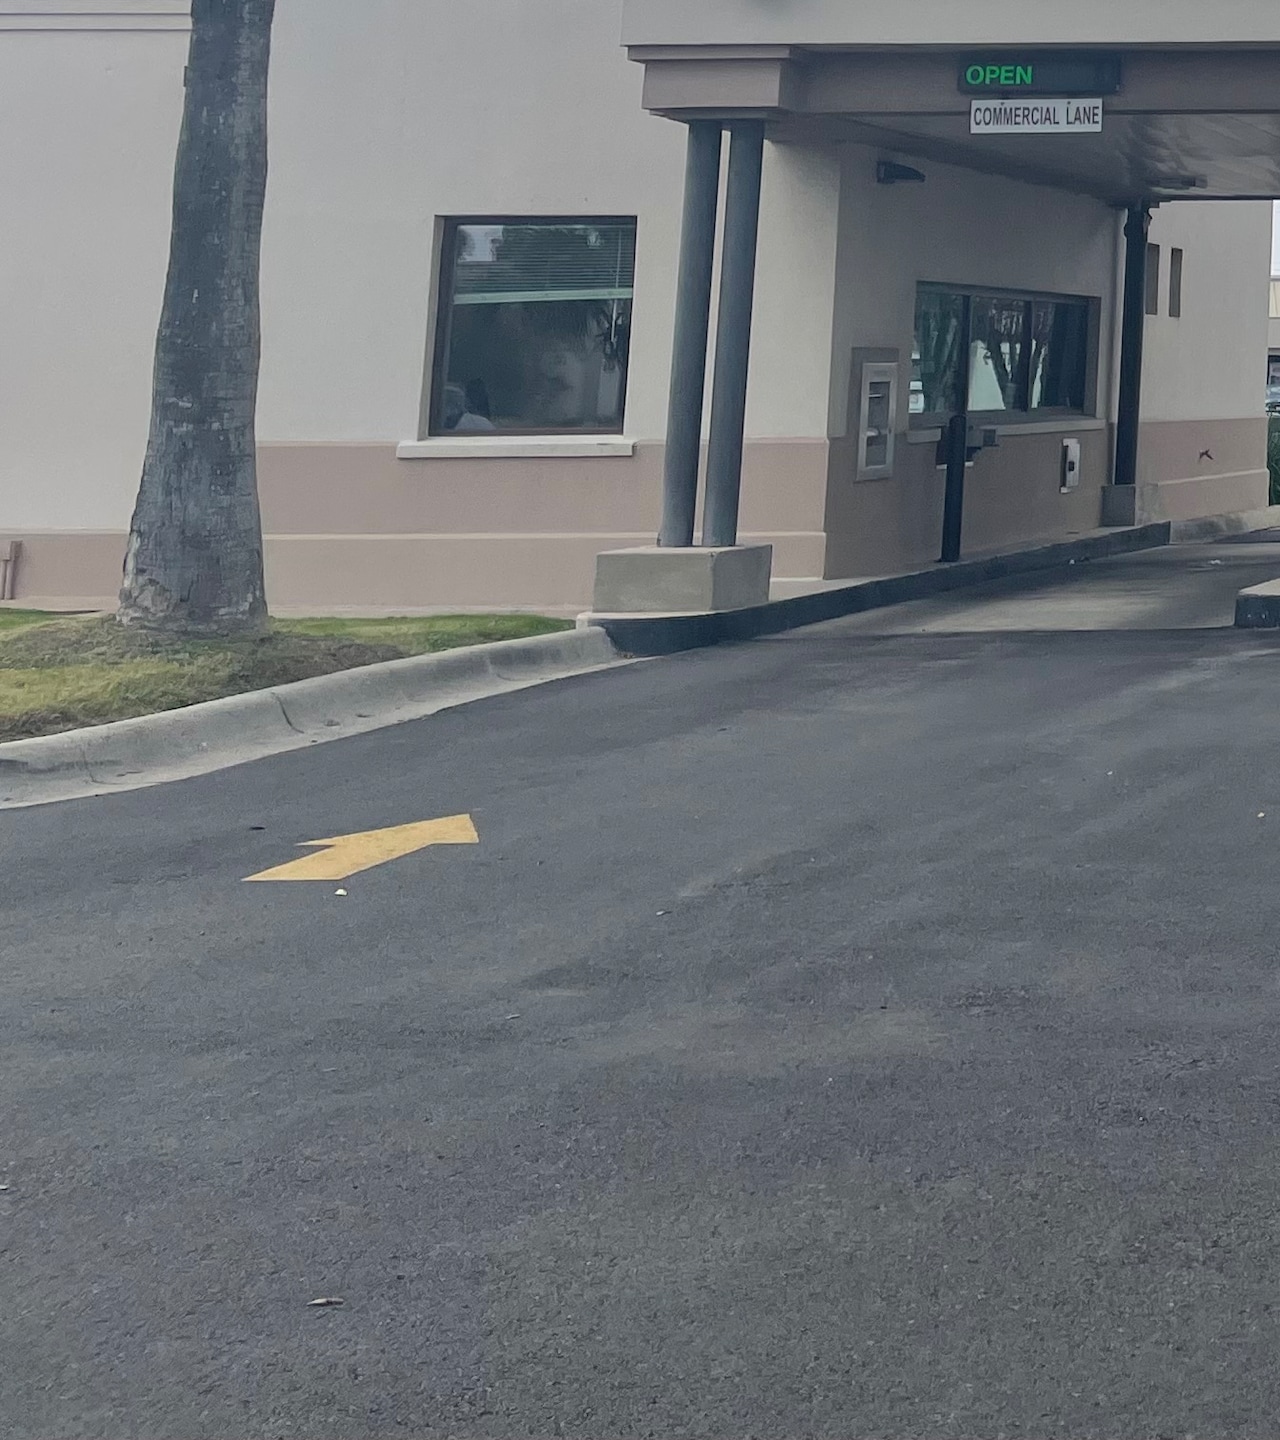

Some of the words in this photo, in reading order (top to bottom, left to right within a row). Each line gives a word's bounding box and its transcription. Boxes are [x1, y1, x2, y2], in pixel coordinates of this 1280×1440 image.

[965, 64, 1034, 85] OPEN
[973, 106, 1060, 126] COMMERCIAL
[1066, 106, 1100, 125] LANE
